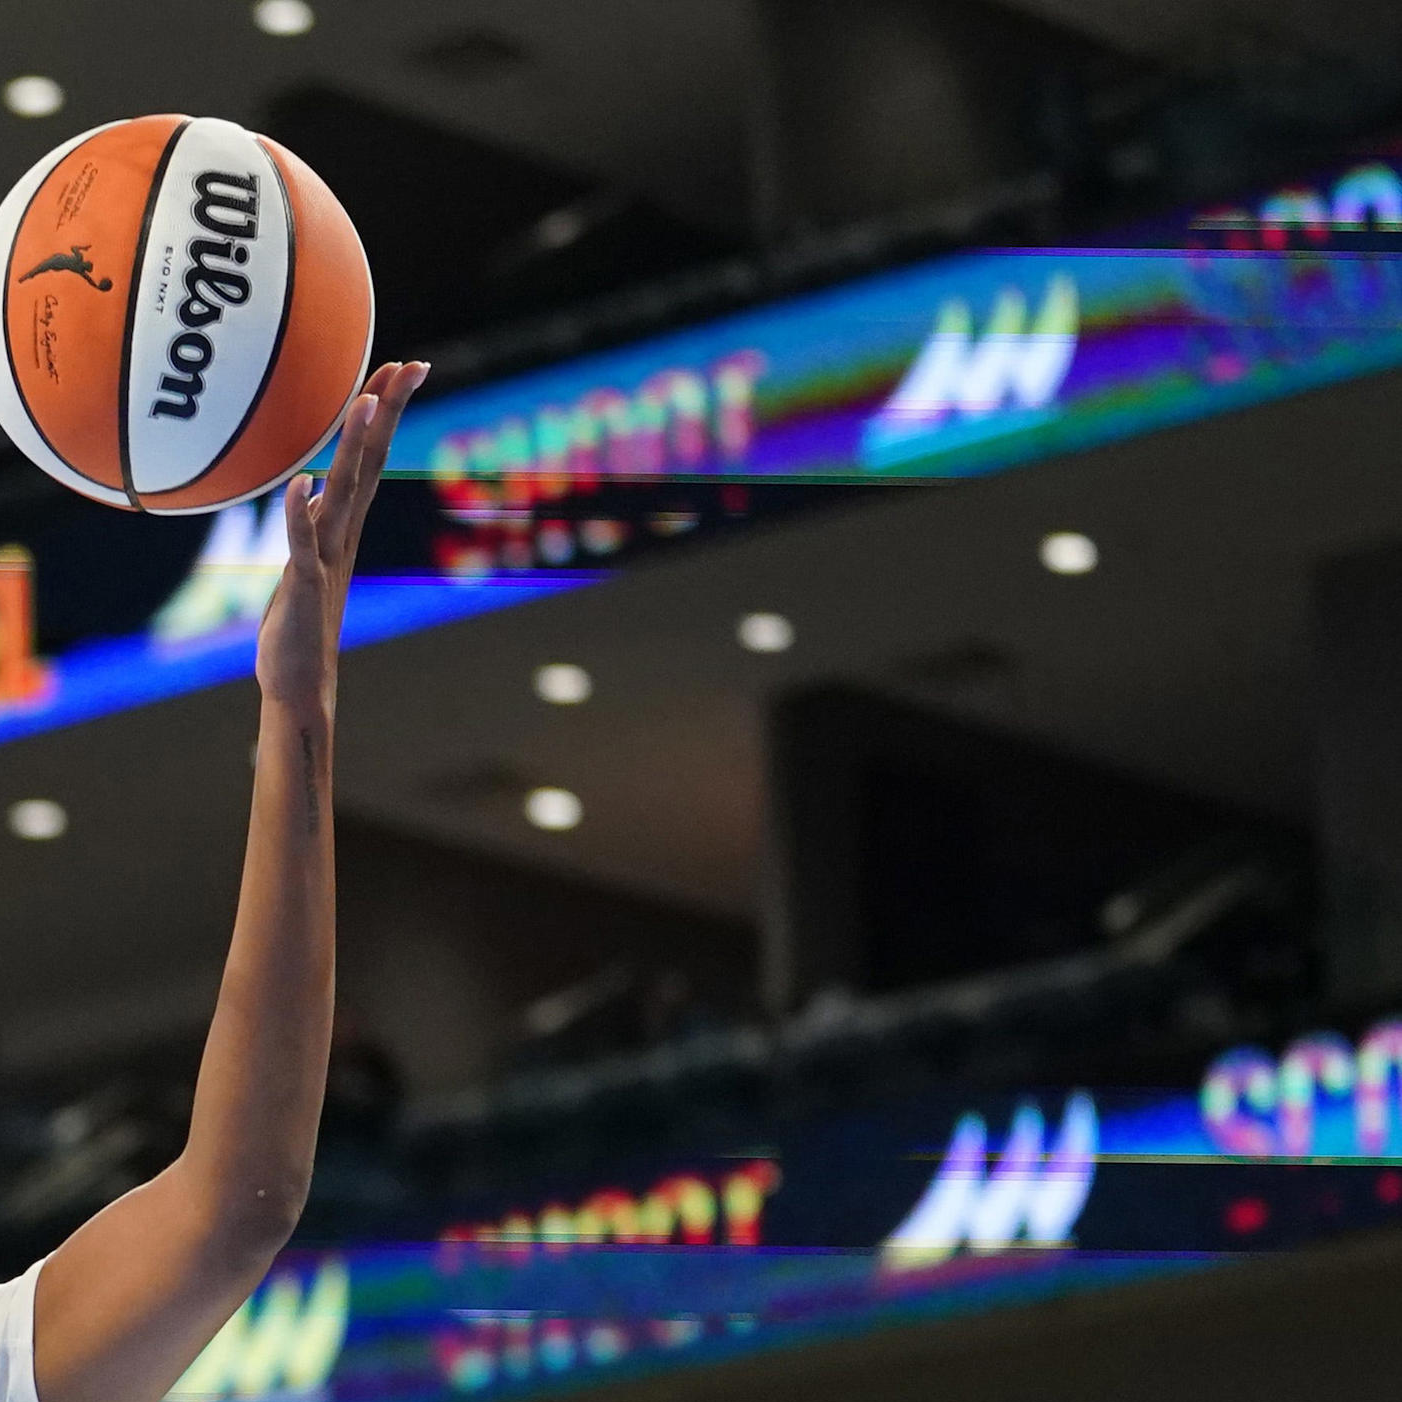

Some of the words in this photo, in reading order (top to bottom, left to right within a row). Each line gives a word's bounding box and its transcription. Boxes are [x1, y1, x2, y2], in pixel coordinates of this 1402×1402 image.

[161, 245, 174, 277] EVO
[148, 169, 261, 421] Wilson
[154, 281, 168, 317] NXT
